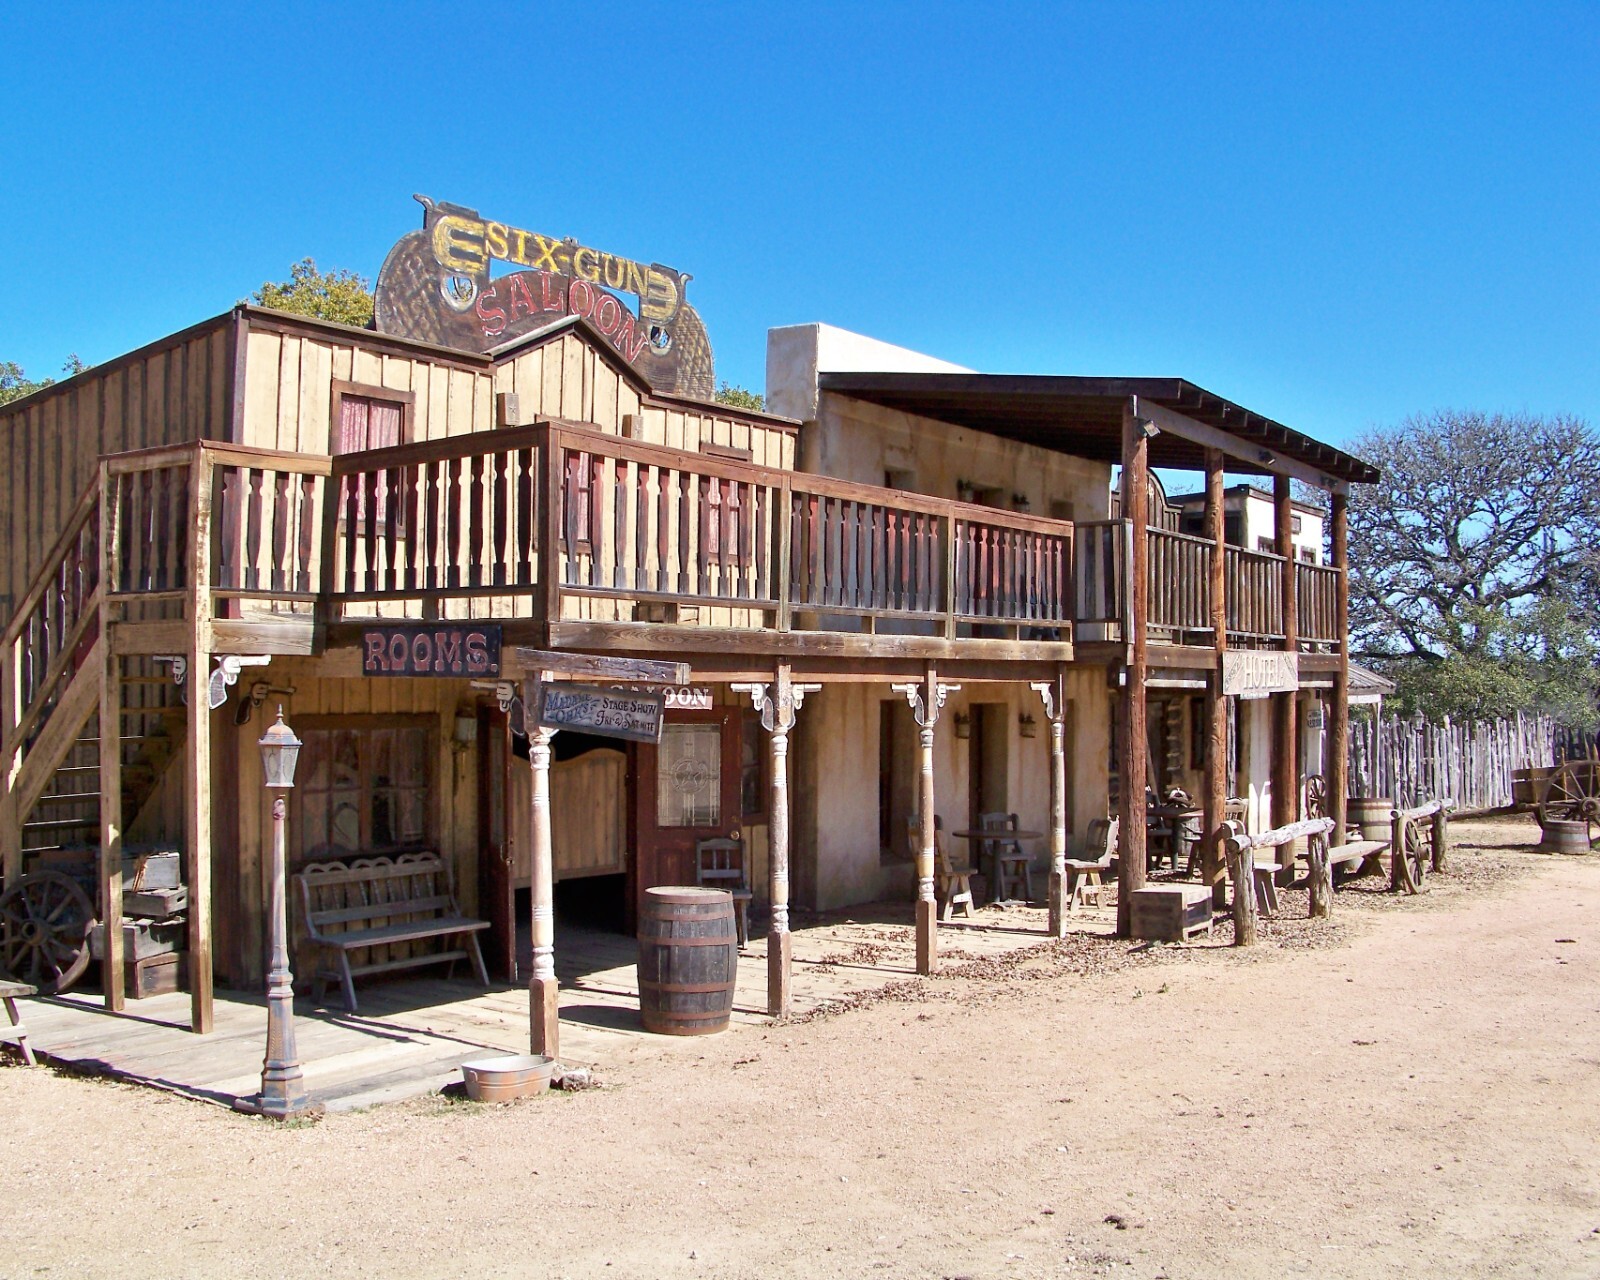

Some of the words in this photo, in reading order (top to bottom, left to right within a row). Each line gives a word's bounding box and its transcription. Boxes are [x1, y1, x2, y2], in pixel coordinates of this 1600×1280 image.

[485, 222, 650, 298] SIX-GUN
[476, 270, 649, 364] SALOON
[1243, 655, 1284, 690] HOTEL
